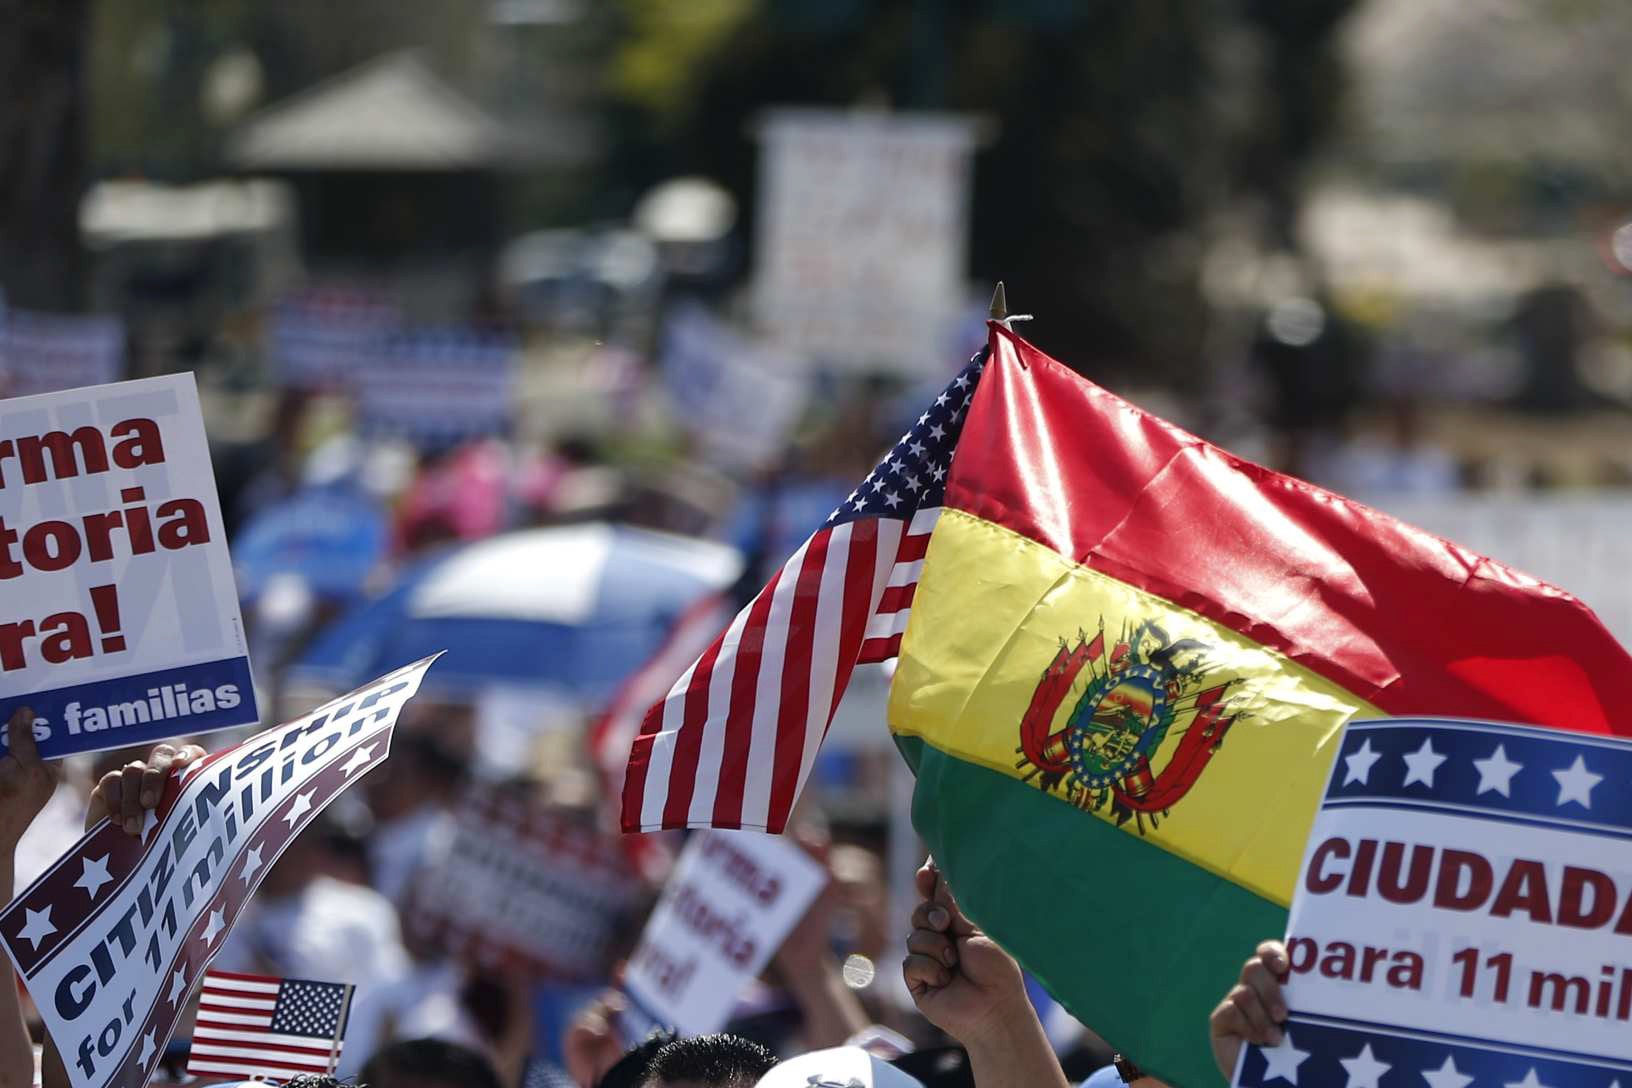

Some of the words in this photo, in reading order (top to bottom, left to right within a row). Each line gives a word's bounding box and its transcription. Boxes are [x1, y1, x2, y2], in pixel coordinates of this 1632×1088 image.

[64, 683, 241, 735] familias
[54, 681, 410, 1021] CITIZENSHIP
[76, 987, 137, 1080] for
[145, 896, 178, 974] 11
[182, 708, 390, 911] million
[1278, 936, 1424, 991] para
[1451, 947, 1513, 1004] 11
